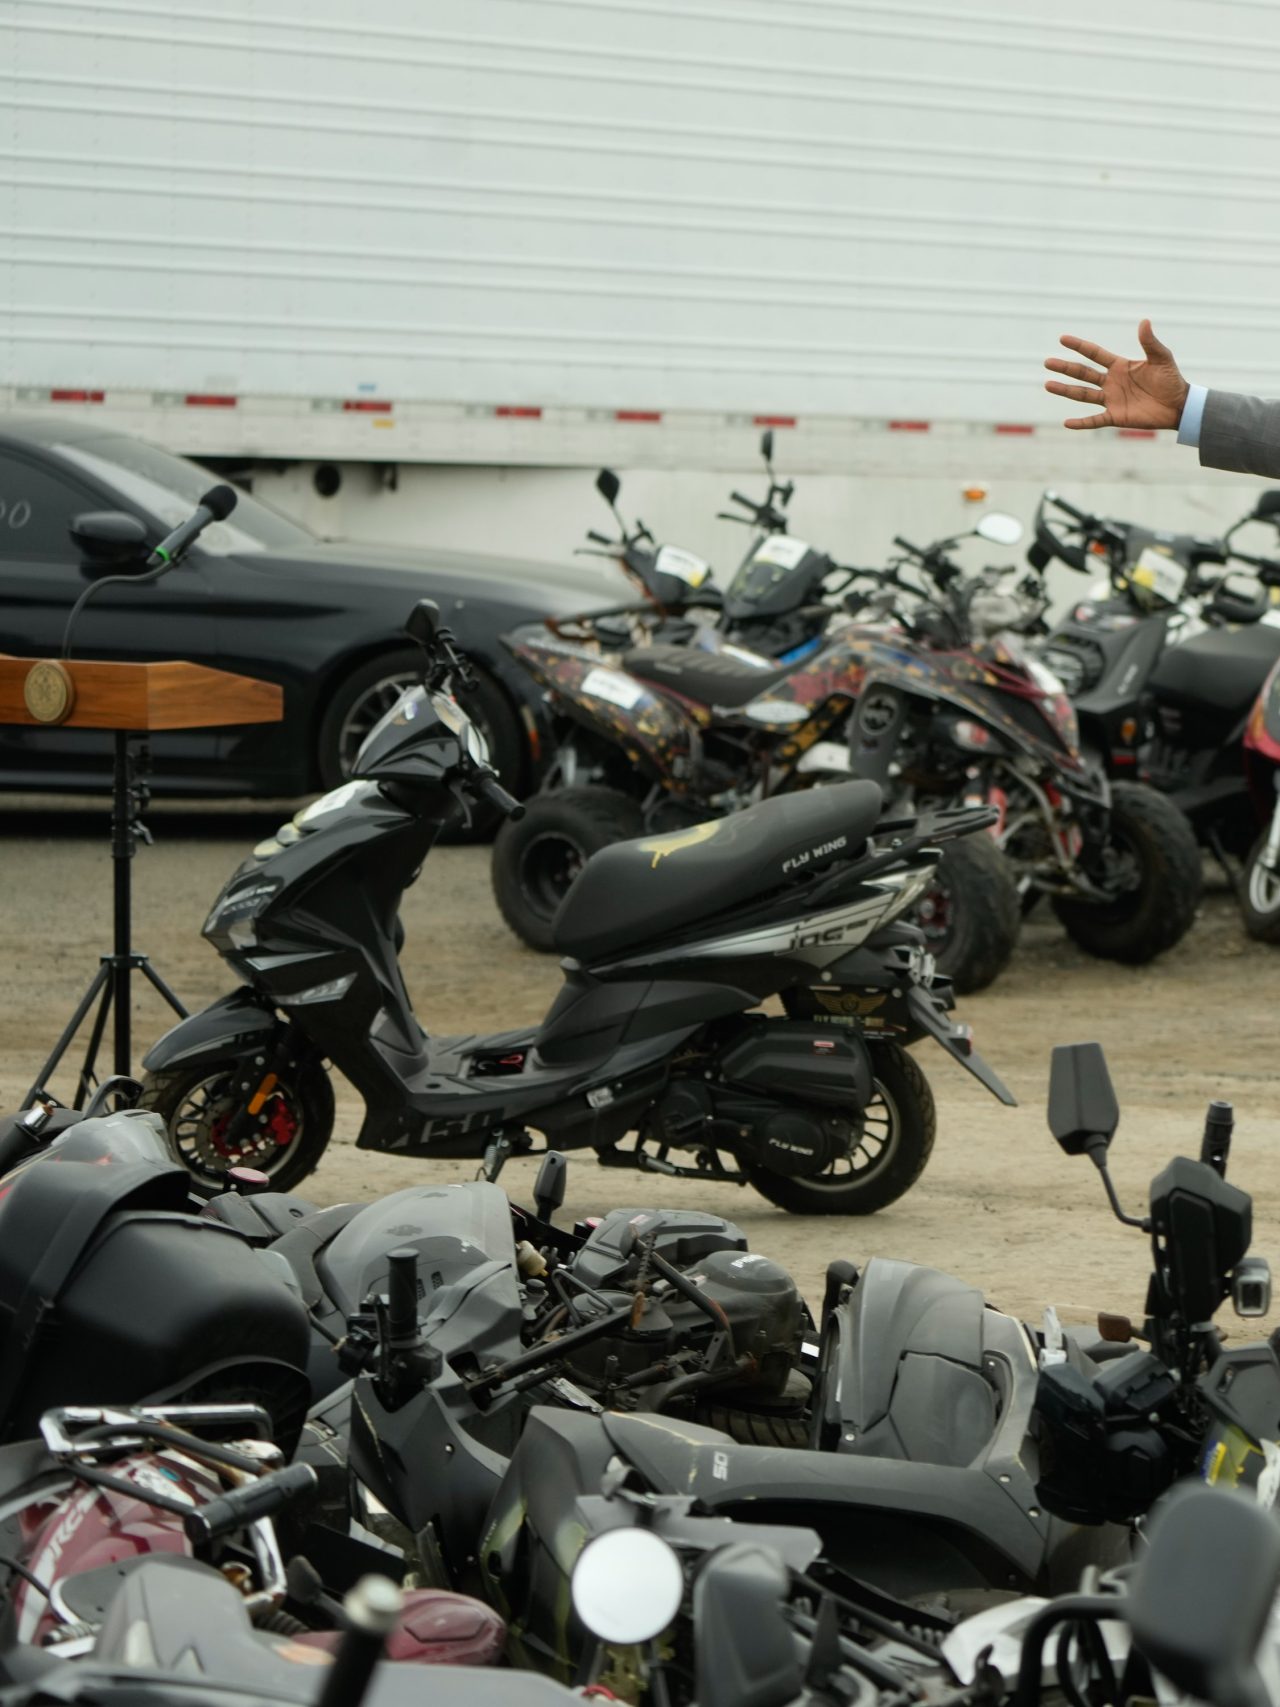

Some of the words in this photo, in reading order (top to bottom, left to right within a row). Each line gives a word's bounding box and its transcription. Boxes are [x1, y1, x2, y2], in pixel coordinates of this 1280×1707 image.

[782, 851, 810, 873] FLY
[812, 835, 847, 858] WING
[712, 1450, 729, 1482] 50
